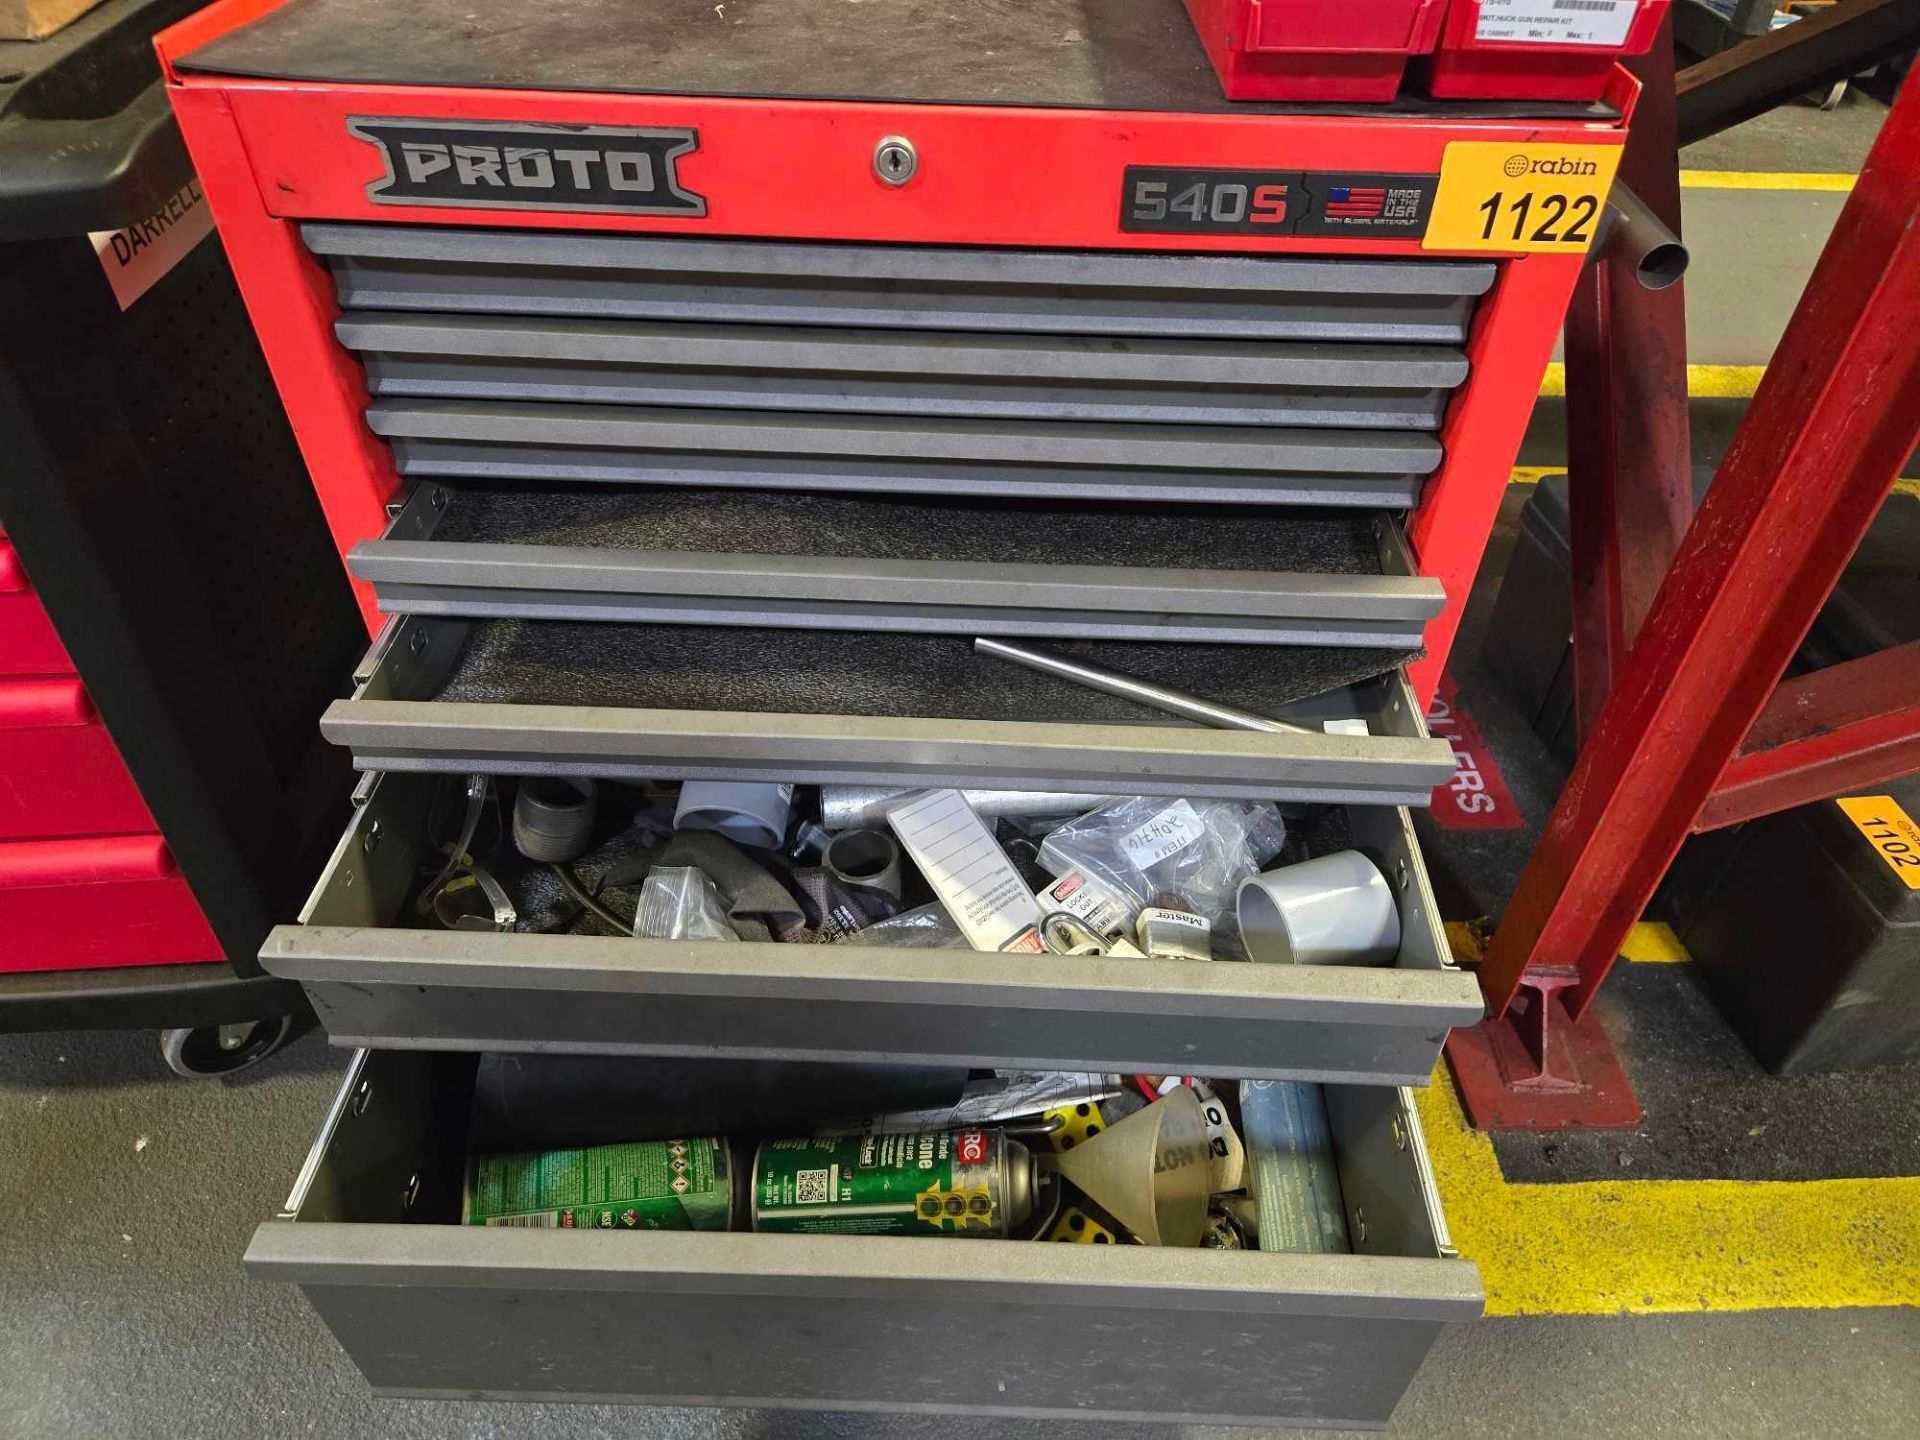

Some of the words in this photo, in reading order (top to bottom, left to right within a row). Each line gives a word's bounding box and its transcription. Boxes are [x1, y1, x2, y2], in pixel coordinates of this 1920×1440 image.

[401, 142, 655, 192] PROTO
[1528, 154, 1598, 178] rabin
[1133, 180, 1288, 223] 540S
[1387, 198, 1397, 207] IN
[1388, 188, 1421, 199] MADE
[1383, 205, 1418, 218] USA
[1477, 190, 1600, 243] 1122
[110, 183, 202, 267] DARRELL
[1861, 814, 1920, 867] 1102
[1080, 898, 1093, 912] OUT
[1155, 910, 1204, 927] Master
[963, 1131, 981, 1160] RC
[841, 1188, 852, 1201] H1
